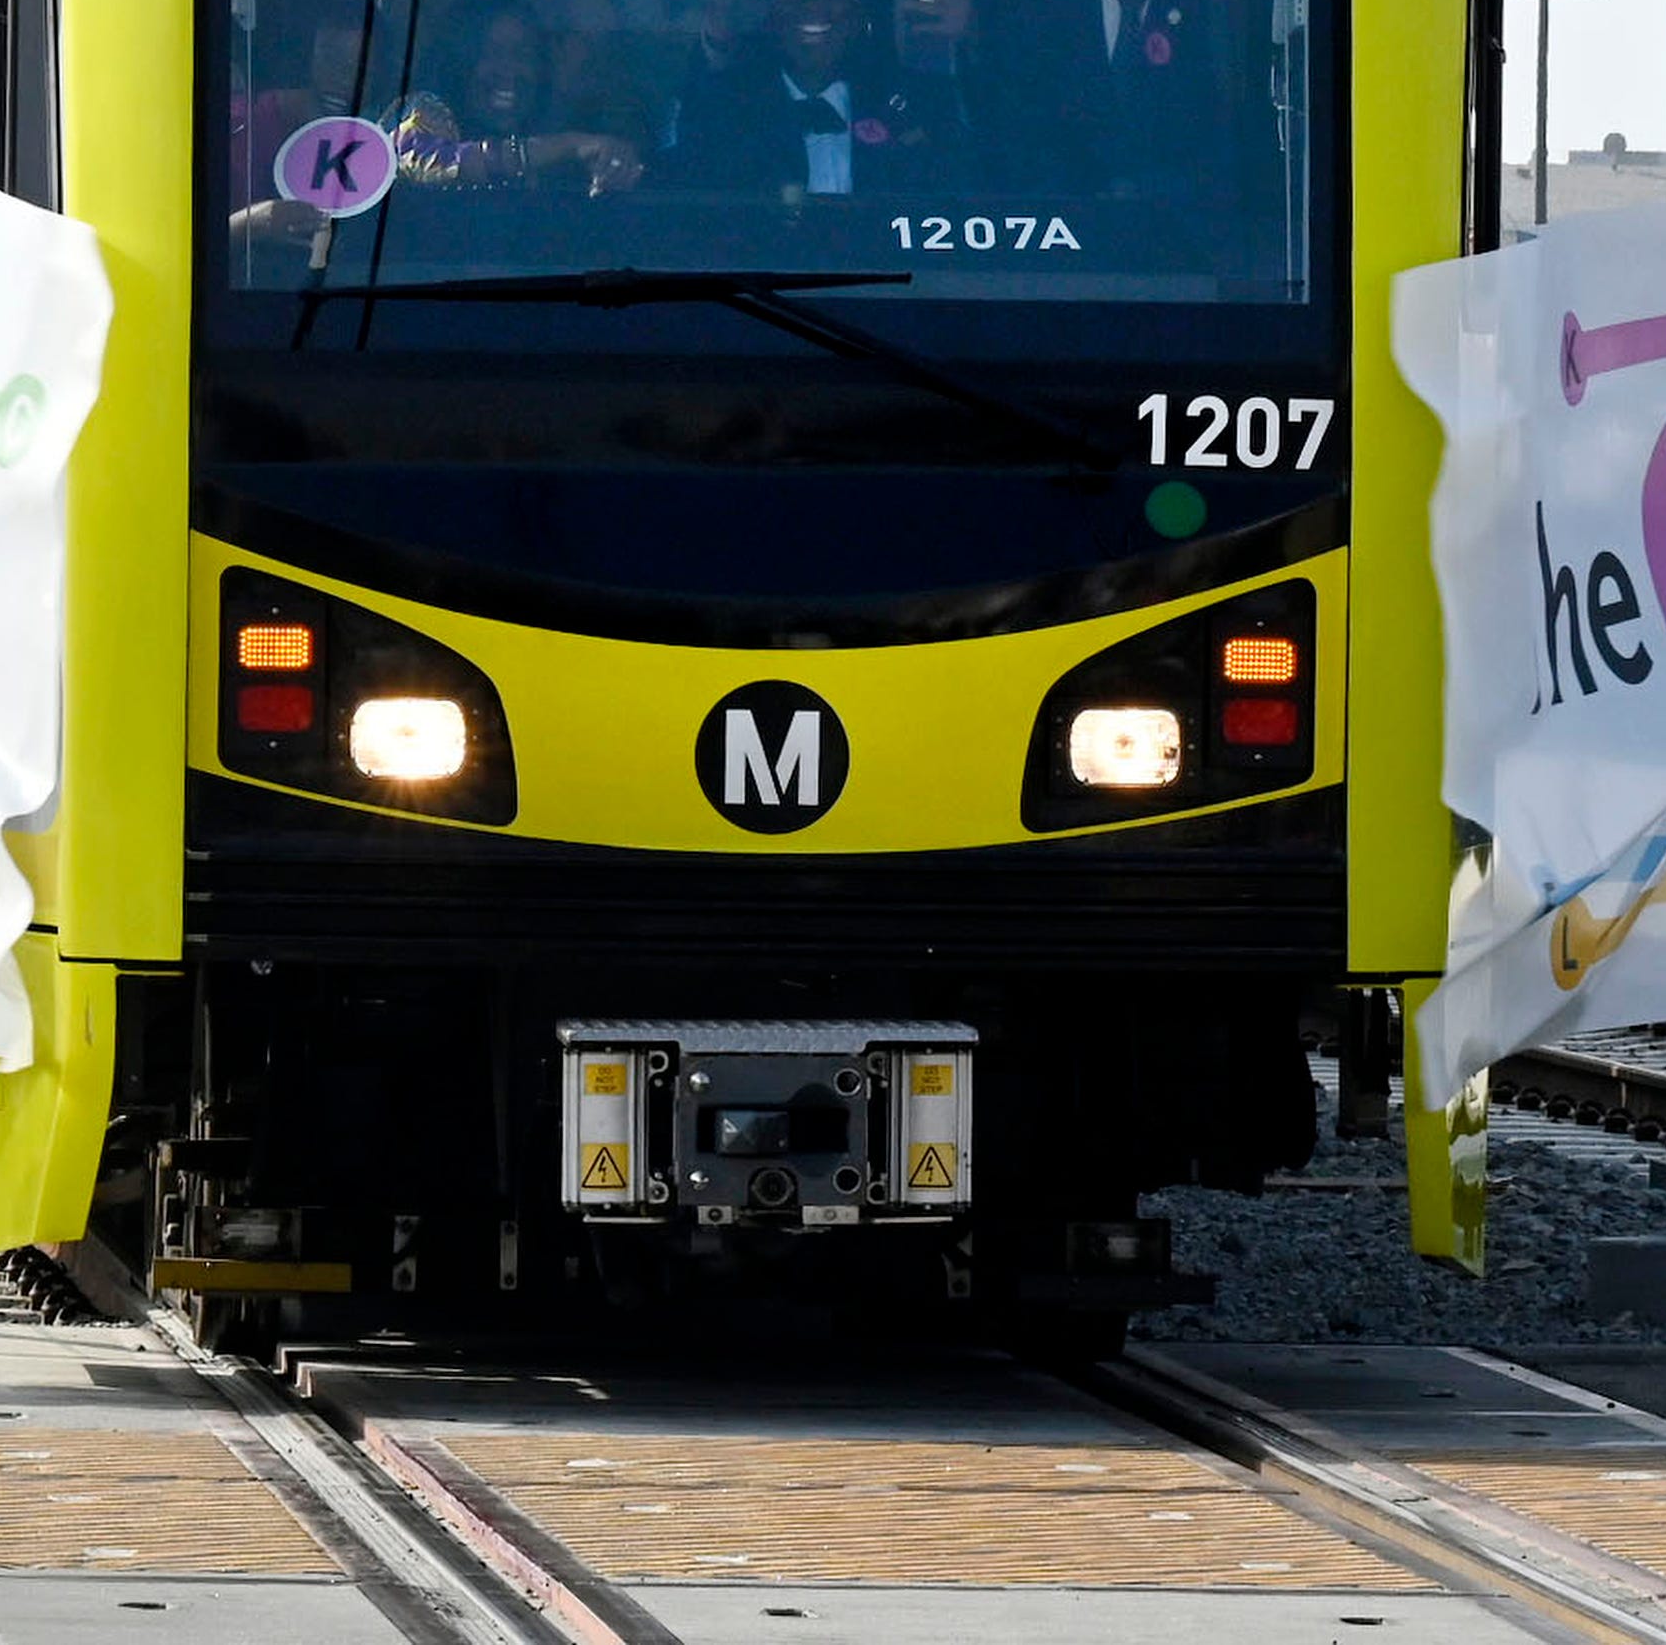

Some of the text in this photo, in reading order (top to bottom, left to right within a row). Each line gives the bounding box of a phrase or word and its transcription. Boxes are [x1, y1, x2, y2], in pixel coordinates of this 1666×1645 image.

[310, 138, 369, 193] K
[890, 214, 1082, 251] 1207A
[1136, 393, 1335, 471] 1207
[1532, 500, 1654, 716] he
[724, 708, 821, 806] M
